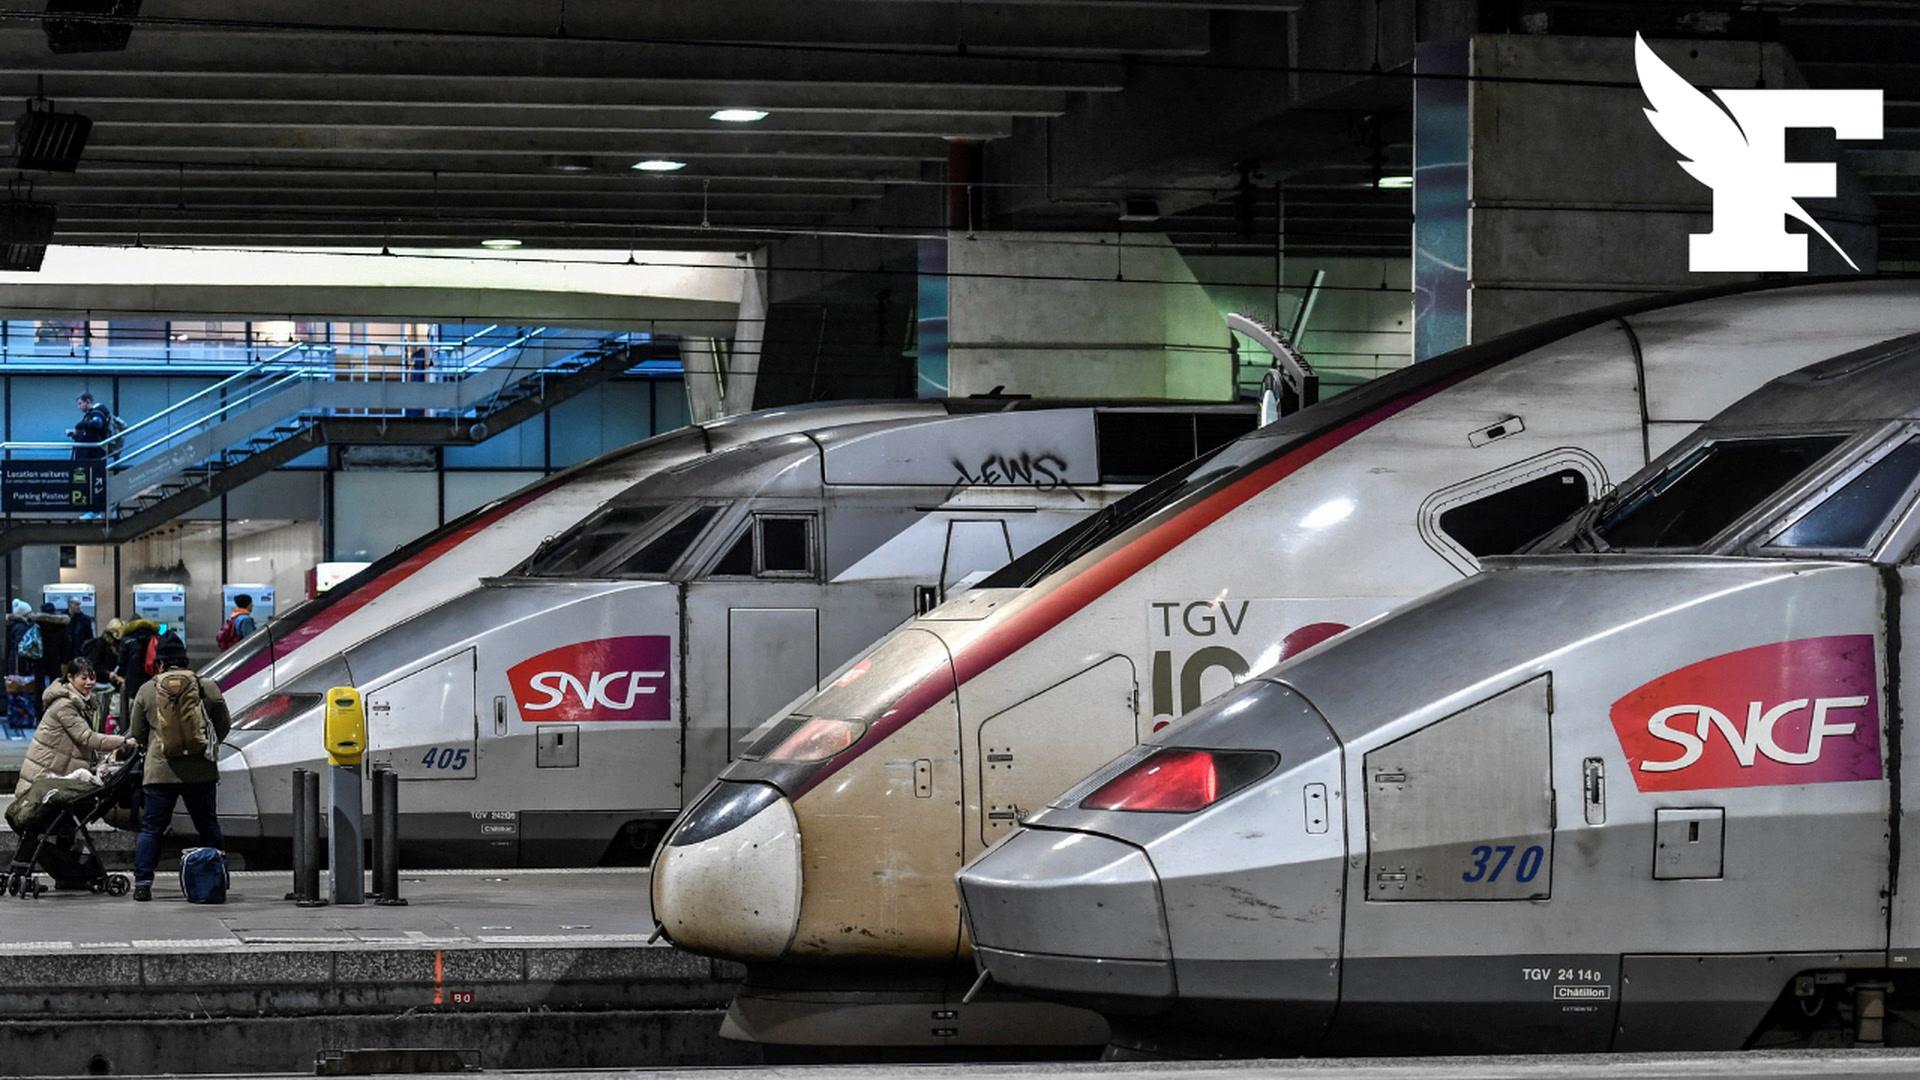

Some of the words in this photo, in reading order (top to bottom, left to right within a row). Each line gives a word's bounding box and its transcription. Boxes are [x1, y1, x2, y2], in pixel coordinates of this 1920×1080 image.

[6, 470, 39, 478] Location
[40, 470, 70, 478] voitures
[13, 491, 41, 501] Parking
[42, 491, 70, 499] Pasteur
[1152, 600, 1250, 637] TGV
[523, 671, 666, 711] SNCF
[1639, 695, 1870, 773] SNCF
[421, 747, 470, 770] 405
[1462, 845, 1545, 883] 370
[1522, 968, 1552, 981] TGV
